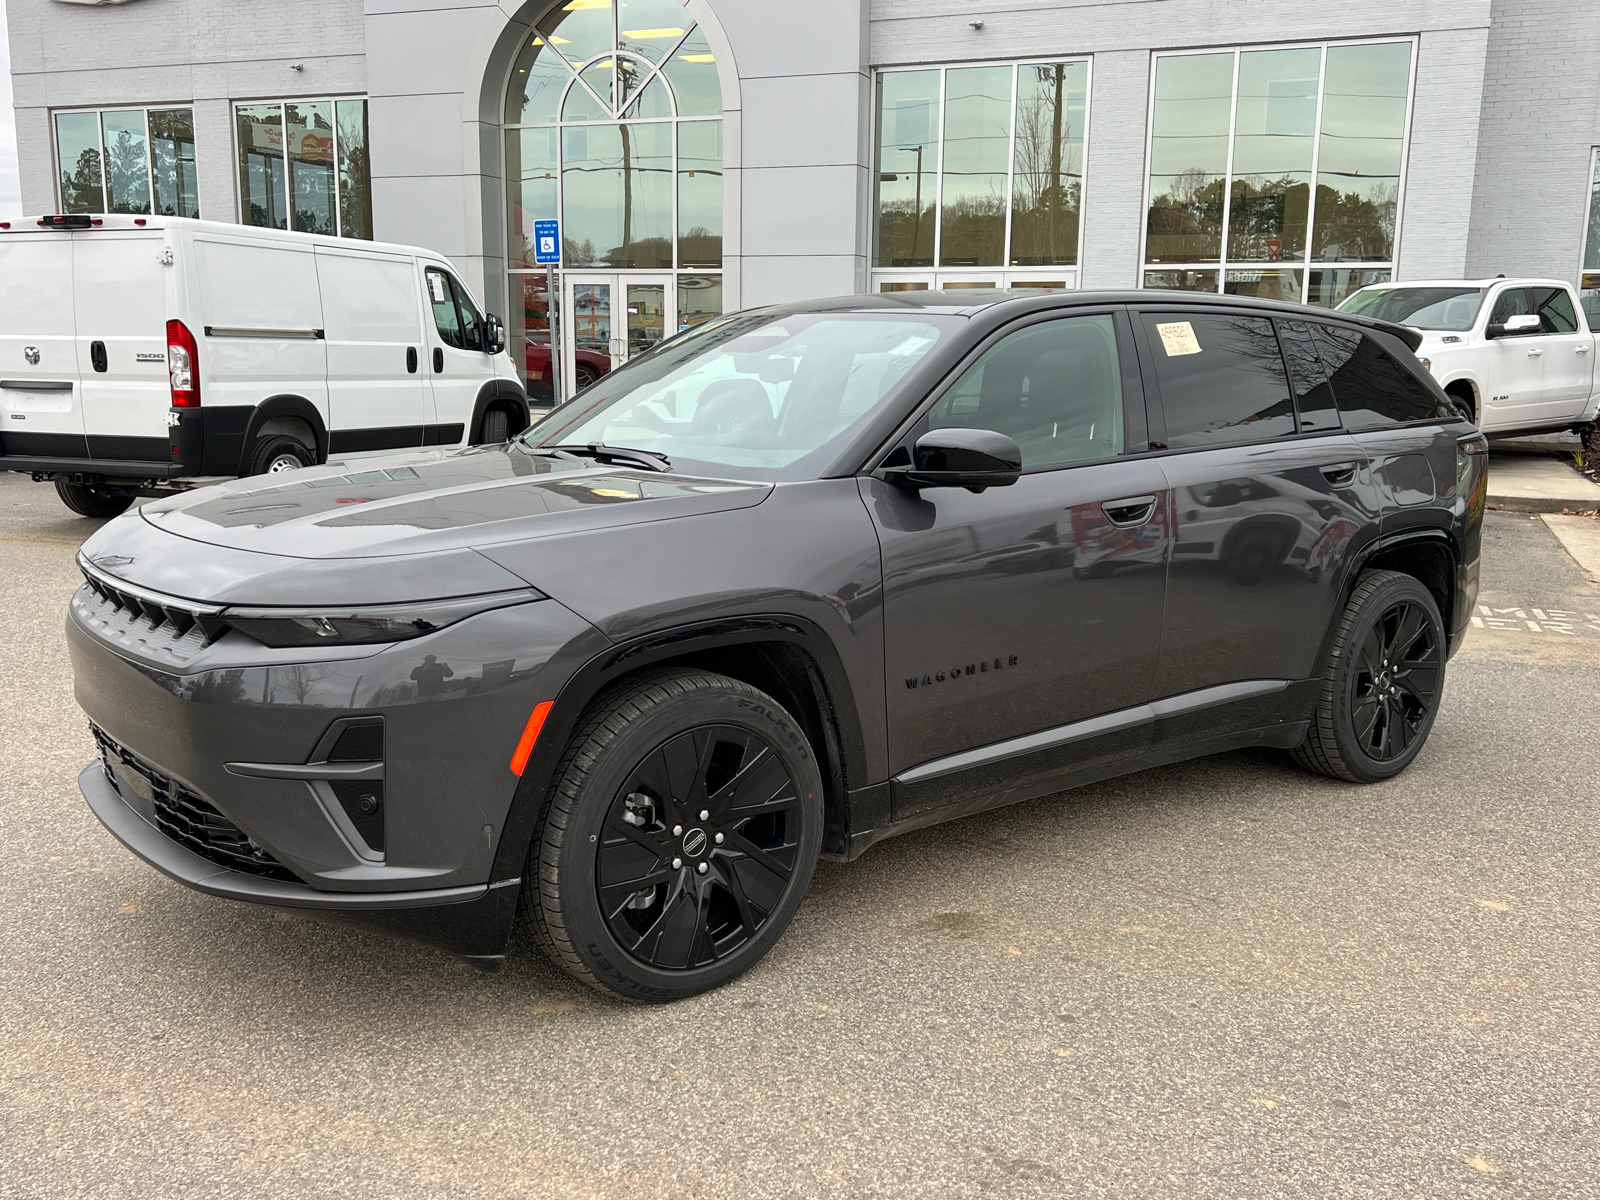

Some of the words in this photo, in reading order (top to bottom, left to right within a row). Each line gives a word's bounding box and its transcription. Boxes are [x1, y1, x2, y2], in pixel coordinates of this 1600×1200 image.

[905, 655, 1018, 690] WAGONEER
[737, 699, 809, 760] FALKEN
[586, 943, 672, 997] FALKEN
